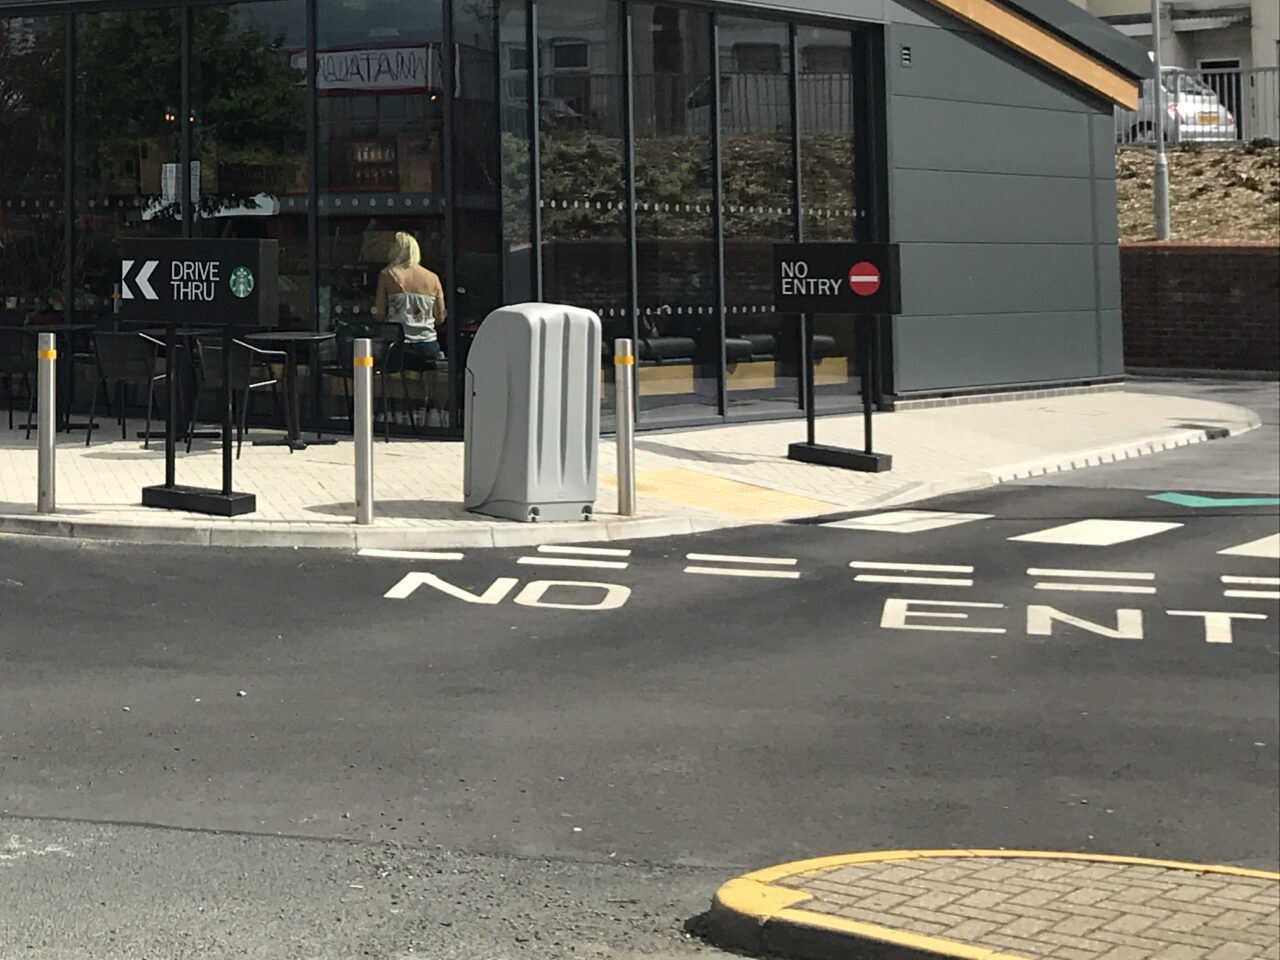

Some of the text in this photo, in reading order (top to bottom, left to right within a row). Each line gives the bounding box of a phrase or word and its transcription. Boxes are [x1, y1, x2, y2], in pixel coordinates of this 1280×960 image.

[171, 261, 220, 280] DRIVE
[781, 261, 808, 278] NO
[170, 281, 214, 300] THRU
[782, 279, 842, 295] ENTRY
[383, 571, 1268, 643] NO ENT
